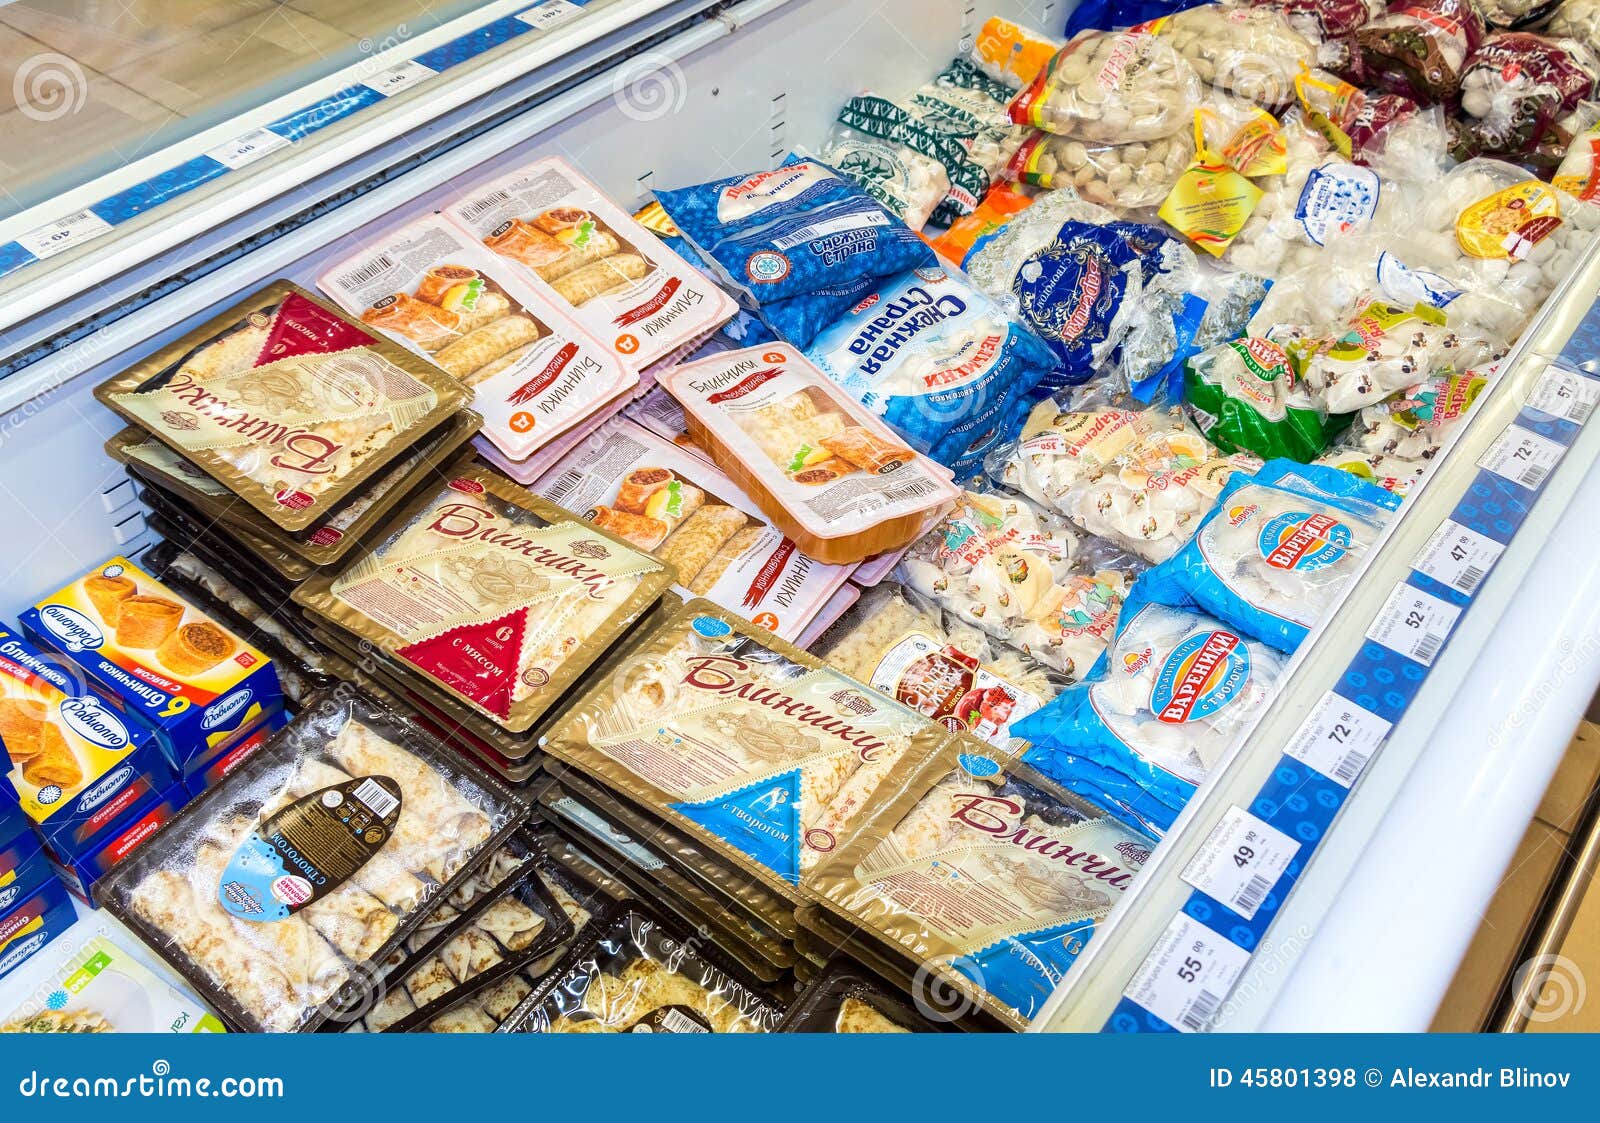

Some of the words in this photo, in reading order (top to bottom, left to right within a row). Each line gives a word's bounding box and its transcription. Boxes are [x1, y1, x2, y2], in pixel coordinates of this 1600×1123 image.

[50, 228, 71, 241] 49
[809, 227, 877, 256] Снежная
[822, 239, 877, 267] Страна
[848, 286, 934, 353] Страна
[860, 294, 967, 376] Снежная
[688, 359, 759, 394] БЛИНЧИКИ
[922, 335, 1002, 389] ПЕЛЬМЕНИ
[1512, 444, 1533, 464] 72
[426, 503, 619, 600] Блинчики
[1271, 515, 1334, 567] ВАРЕНИКИ
[1449, 544, 1468, 563] 47
[1404, 609, 1425, 630] 52
[1413, 599, 1424, 609] 50
[46, 606, 101, 649] Равиолло
[495, 625, 511, 644] 6
[1, 641, 67, 686] блинчиков
[133, 666, 172, 691] мясом
[463, 641, 505, 682] мясом
[1163, 632, 1233, 720] ВАРЕНИКИ
[98, 660, 166, 708] блинчиков
[64, 702, 123, 745] Равиолло
[158, 696, 191, 718] 6
[204, 688, 250, 728] Равиолло
[681, 655, 889, 763] Блинчики
[1327, 721, 1352, 746] 72
[1340, 711, 1352, 723] 00
[731, 803, 791, 845] творогом
[952, 792, 1131, 892] Блинчи
[272, 833, 321, 881] ТВОРОГОМ
[1229, 842, 1257, 871] 49
[1245, 829, 1258, 843] 90
[1062, 935, 1082, 955] 6
[1176, 954, 1204, 985] 55
[1191, 939, 1205, 954] 00
